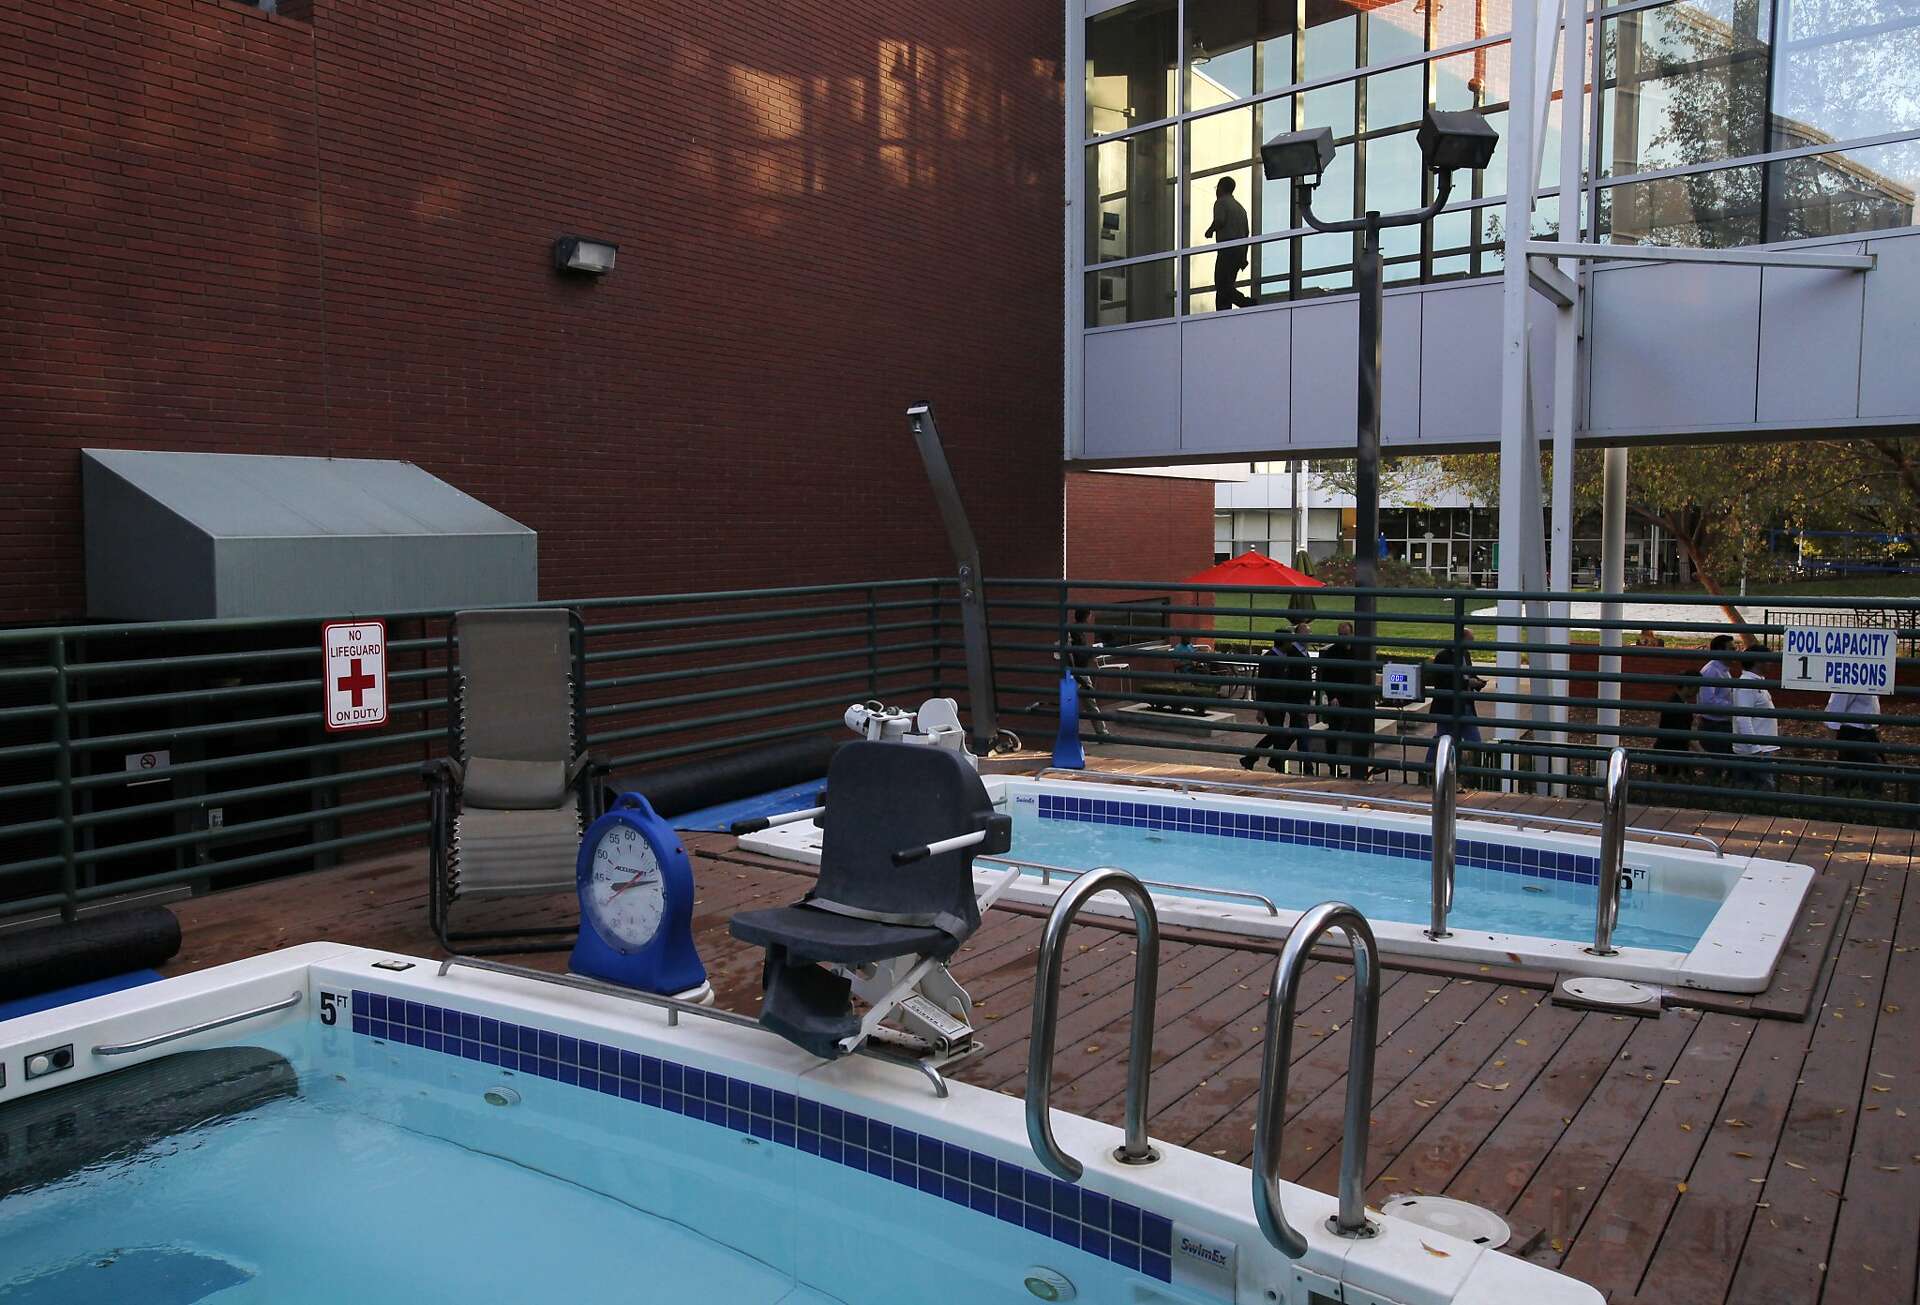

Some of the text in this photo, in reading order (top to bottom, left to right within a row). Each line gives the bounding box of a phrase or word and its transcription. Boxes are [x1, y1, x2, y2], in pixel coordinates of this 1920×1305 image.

[348, 630, 362, 641] NO
[1788, 630, 1889, 656] POOL CAPACITY
[330, 644, 381, 658] LIFEGUARD
[1797, 656, 1887, 687] 1 PERSONS
[336, 707, 379, 721] ON DUTY
[609, 832, 620, 845] 55
[624, 830, 637, 841] 60
[597, 848, 609, 860] 50
[1633, 869, 1647, 880] FT
[320, 991, 349, 1026] 5 FT
[1180, 1237, 1227, 1265] SwimEx
